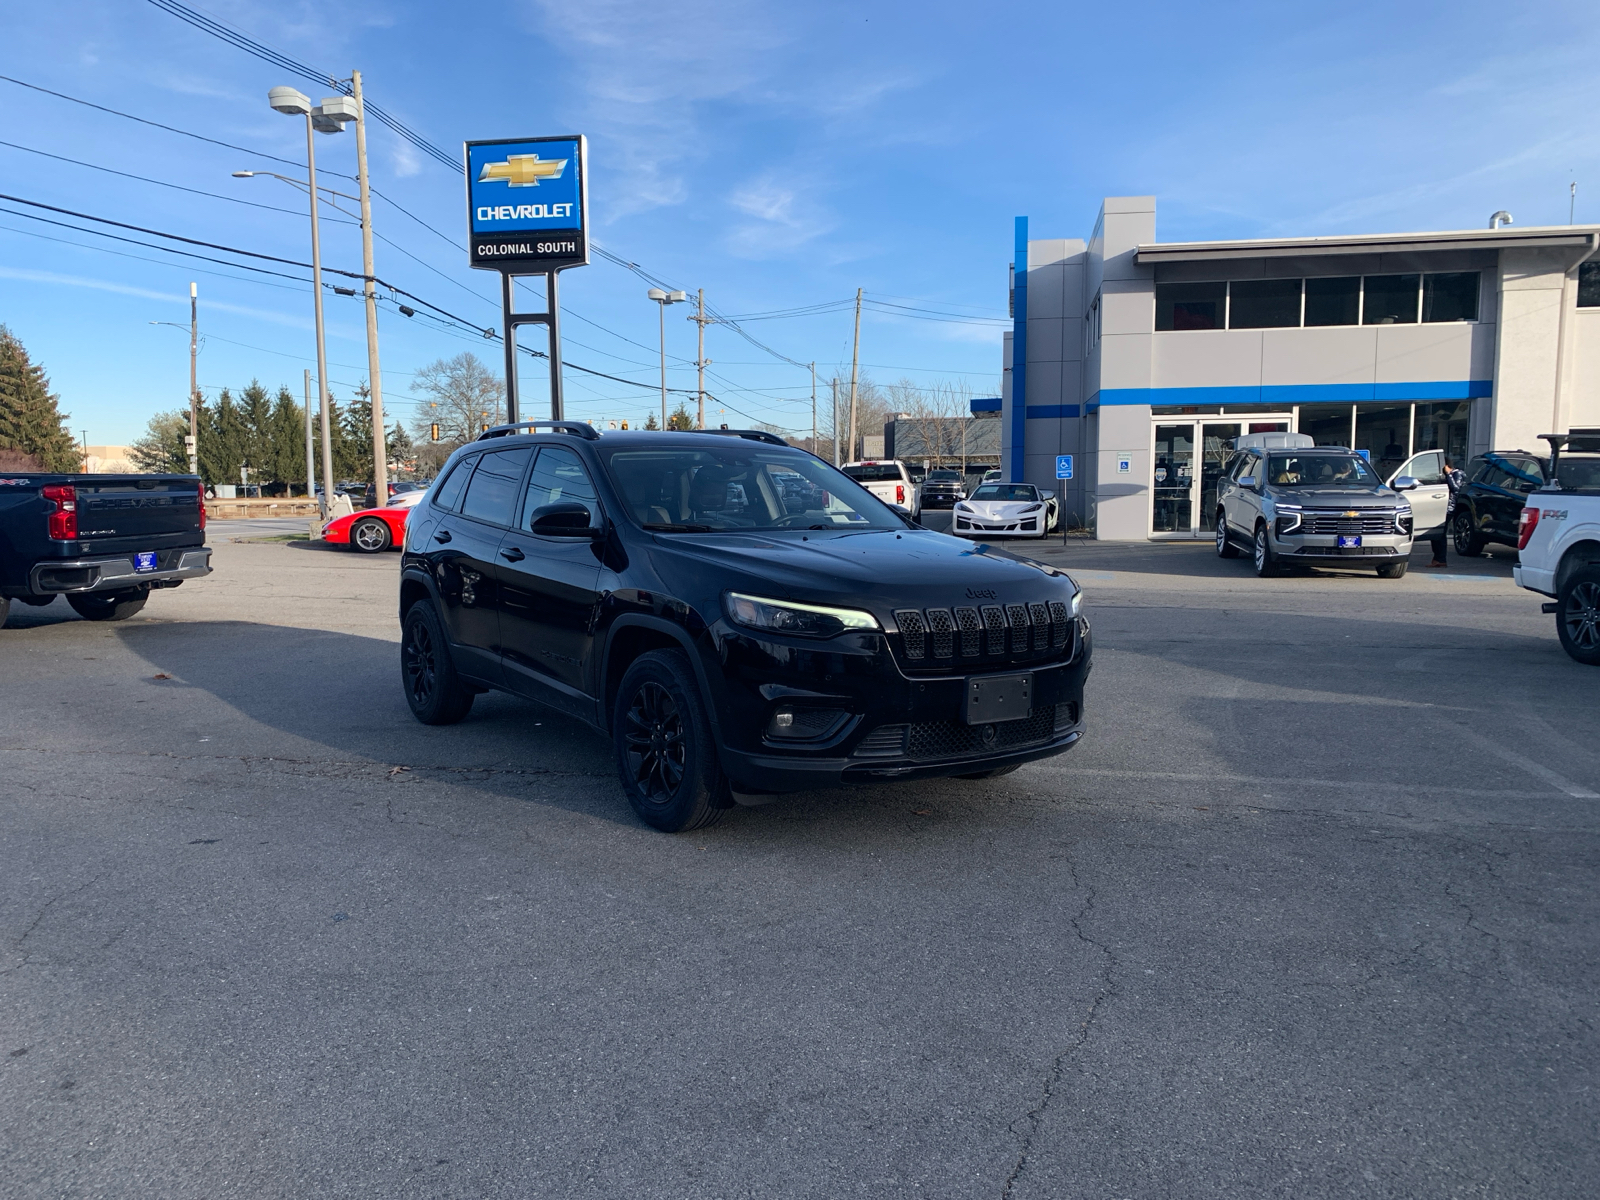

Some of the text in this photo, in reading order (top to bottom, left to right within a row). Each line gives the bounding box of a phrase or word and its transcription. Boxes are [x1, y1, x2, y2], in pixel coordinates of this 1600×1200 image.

[477, 203, 573, 221] CHEVROLET
[478, 241, 575, 256] COLONIAL SOUTH
[1542, 509, 1568, 519] FX4
[965, 587, 998, 600] Jeep
